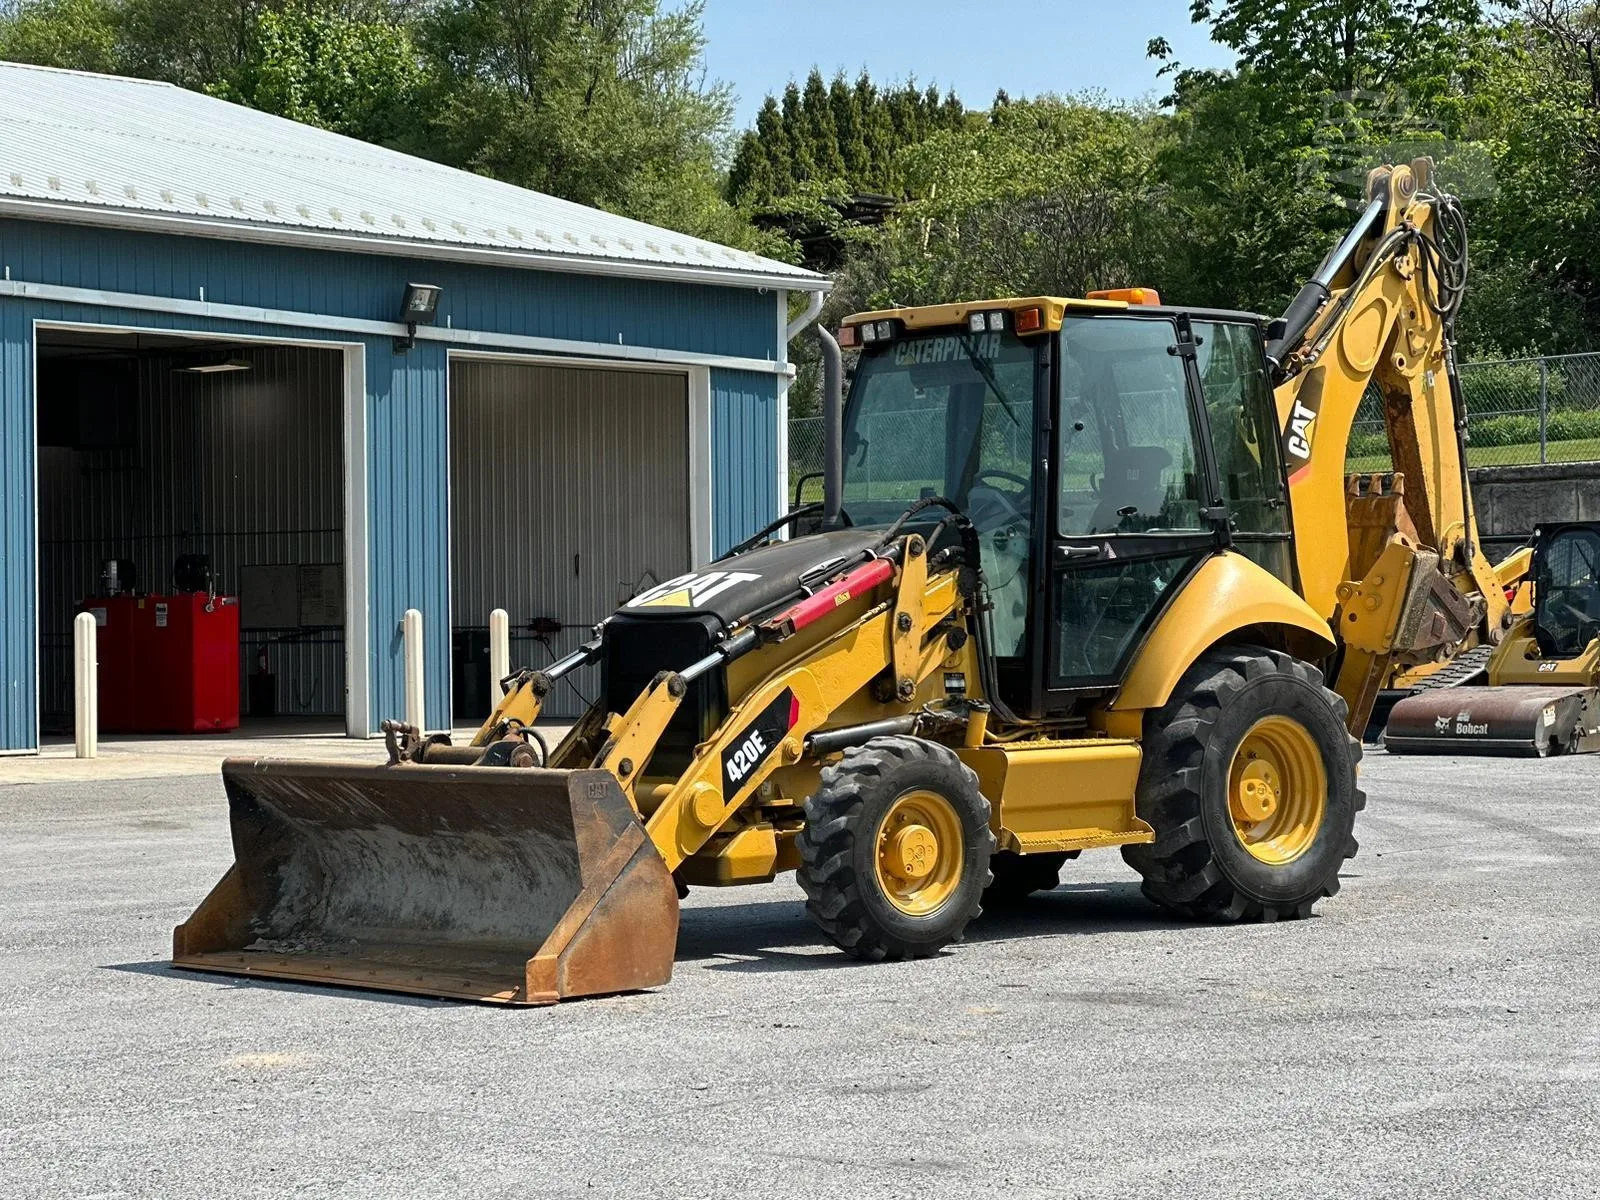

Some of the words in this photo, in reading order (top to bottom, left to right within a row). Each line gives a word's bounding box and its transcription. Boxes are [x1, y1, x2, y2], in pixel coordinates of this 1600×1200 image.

[1288, 399, 1317, 459] CAT
[627, 572, 762, 607] CAT
[1538, 663, 1557, 672] CAT
[1456, 722, 1488, 735] Bobcat
[726, 729, 767, 782] 420E
[586, 782, 608, 799] CAT
